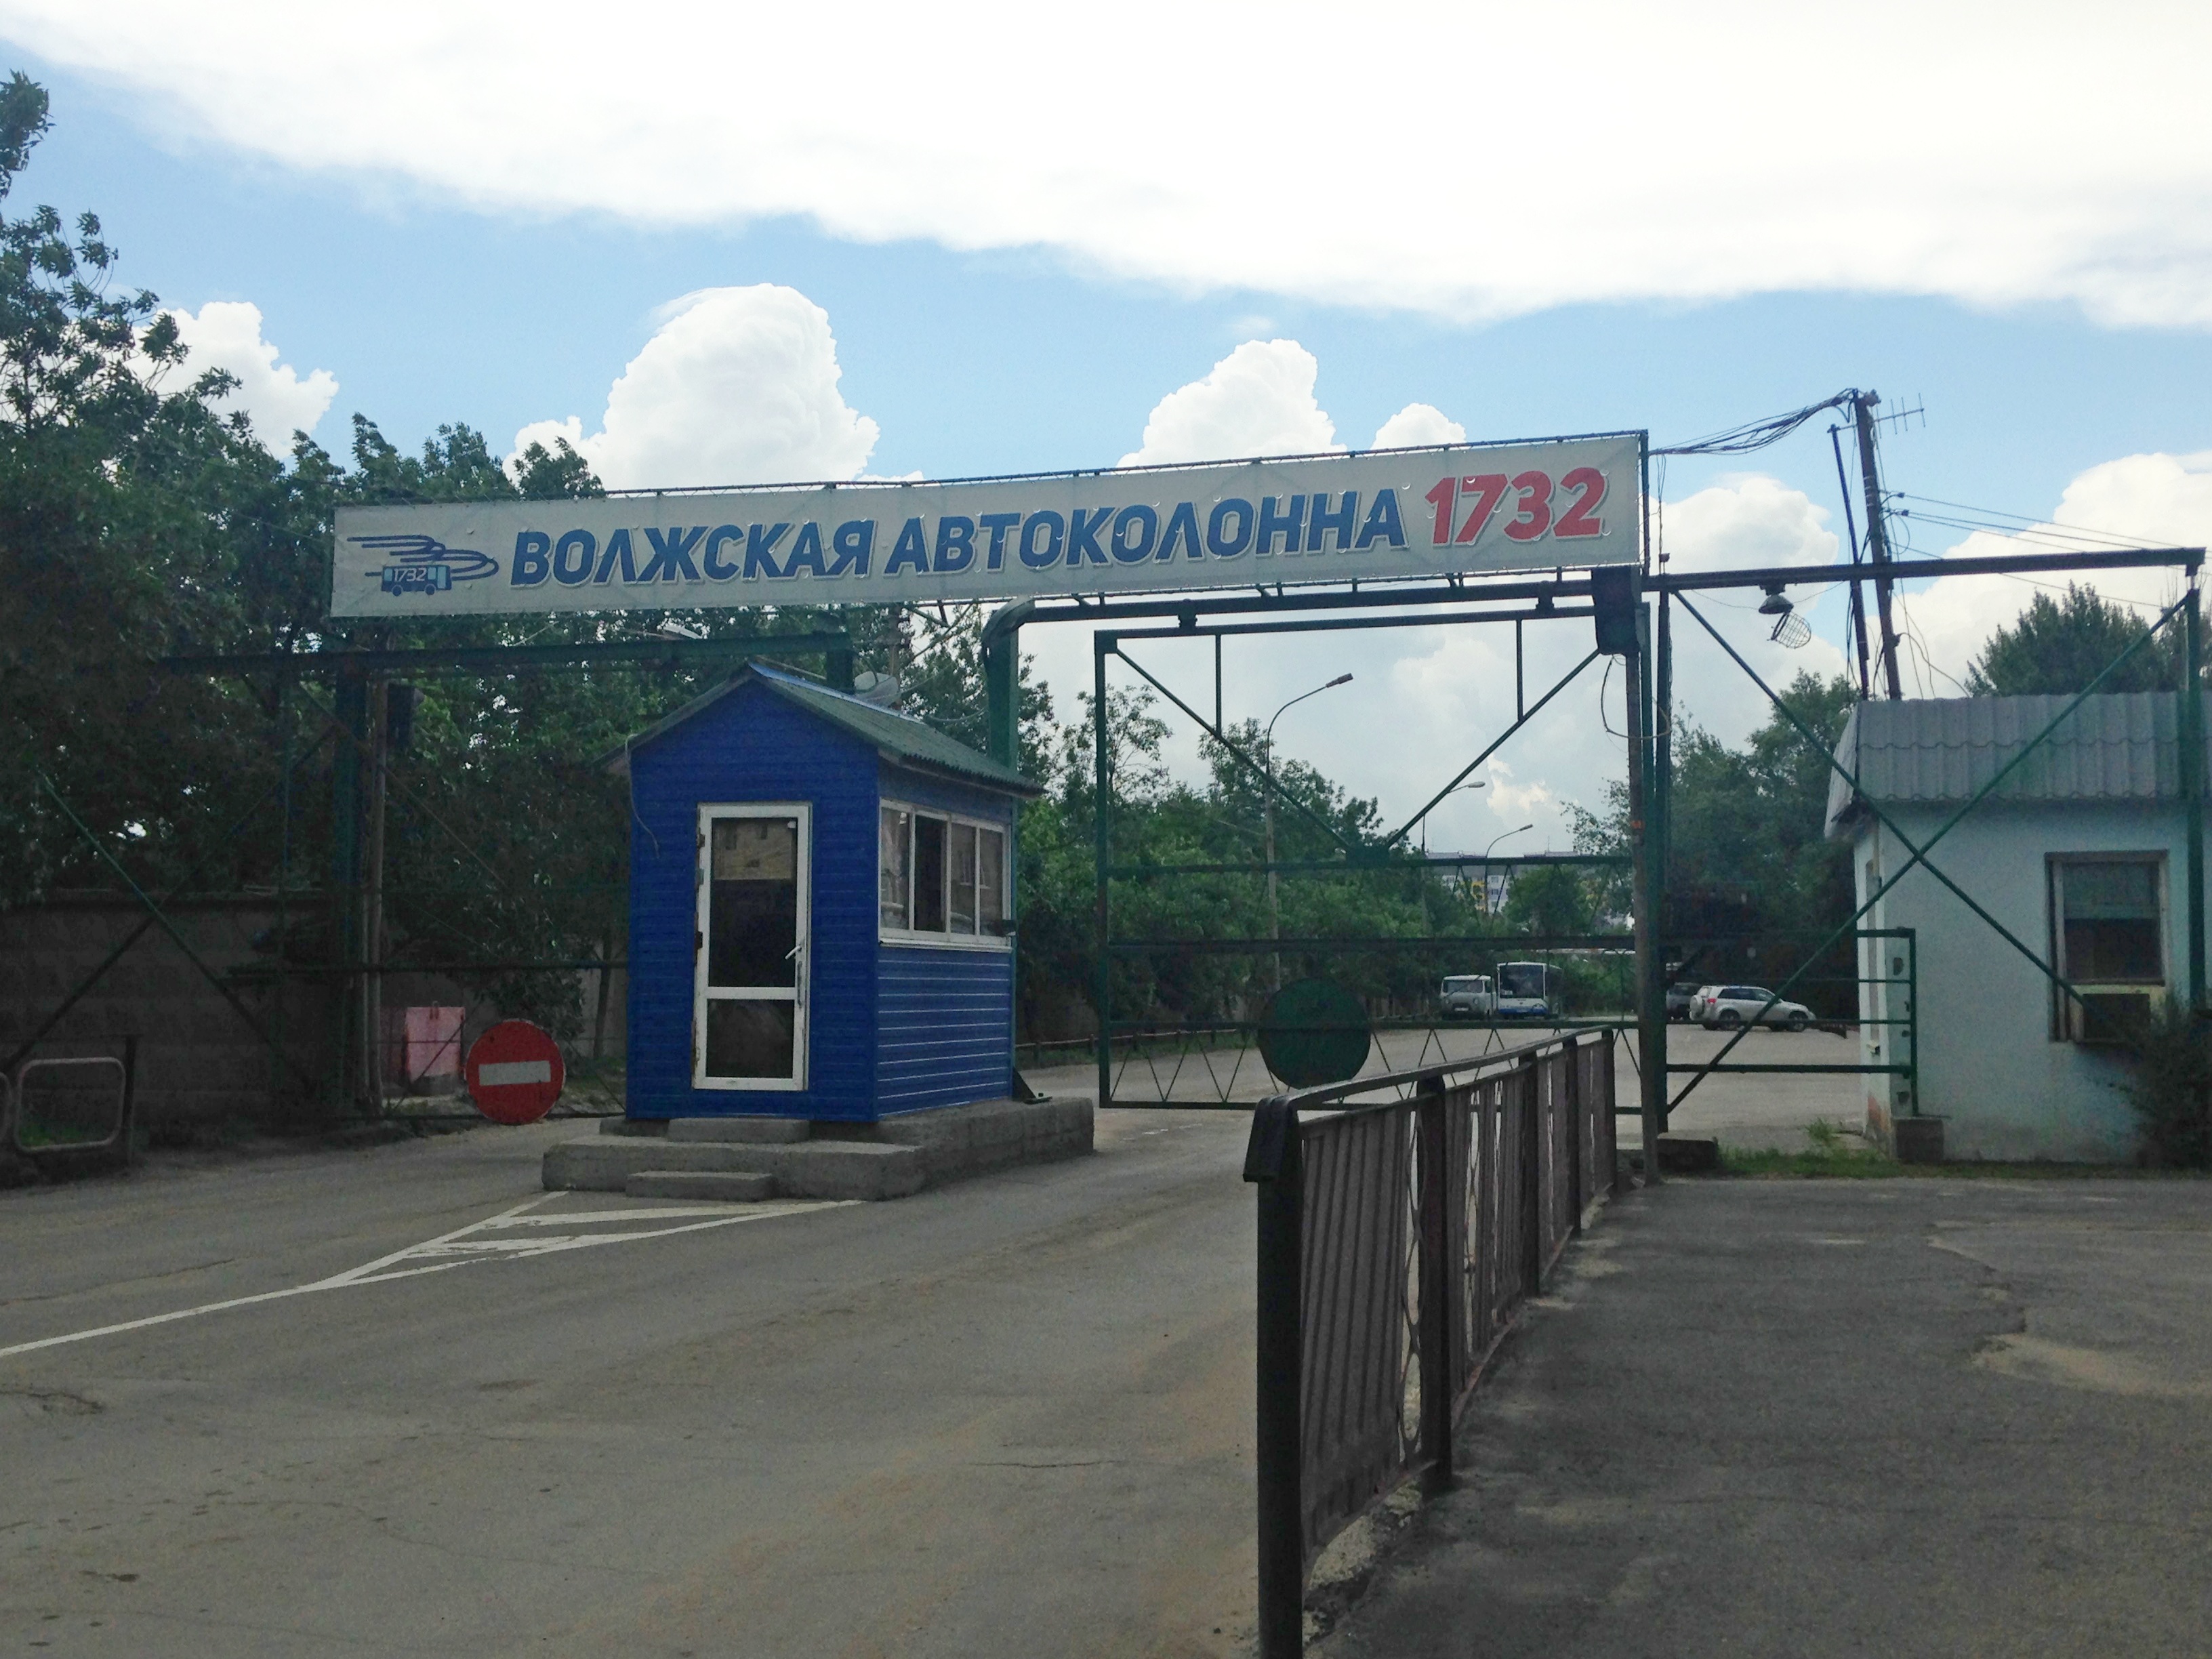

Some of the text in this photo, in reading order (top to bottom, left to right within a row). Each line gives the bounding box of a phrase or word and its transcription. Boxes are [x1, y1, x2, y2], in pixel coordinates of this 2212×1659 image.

[510, 467, 1609, 586] ВОЛЖСКАЯ АВТОКОЛОННА 1732
[393, 567, 428, 581] 1732
